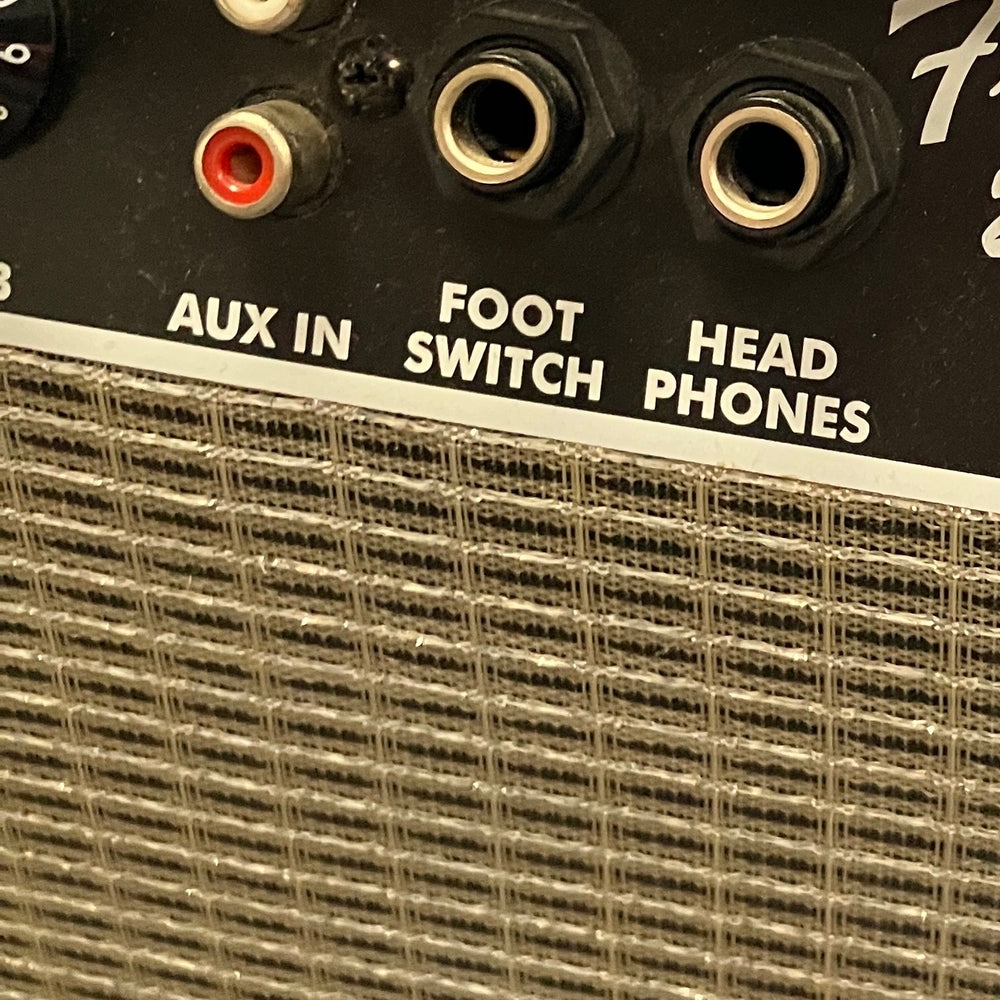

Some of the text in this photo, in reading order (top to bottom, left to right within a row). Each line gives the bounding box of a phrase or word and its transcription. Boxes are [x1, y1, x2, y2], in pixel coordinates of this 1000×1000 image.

[166, 292, 352, 361] AUX IN
[439, 281, 584, 342] FOOT
[403, 331, 604, 401] SWITCH
[687, 320, 838, 381] HEAD
[643, 368, 871, 444] PHONES
